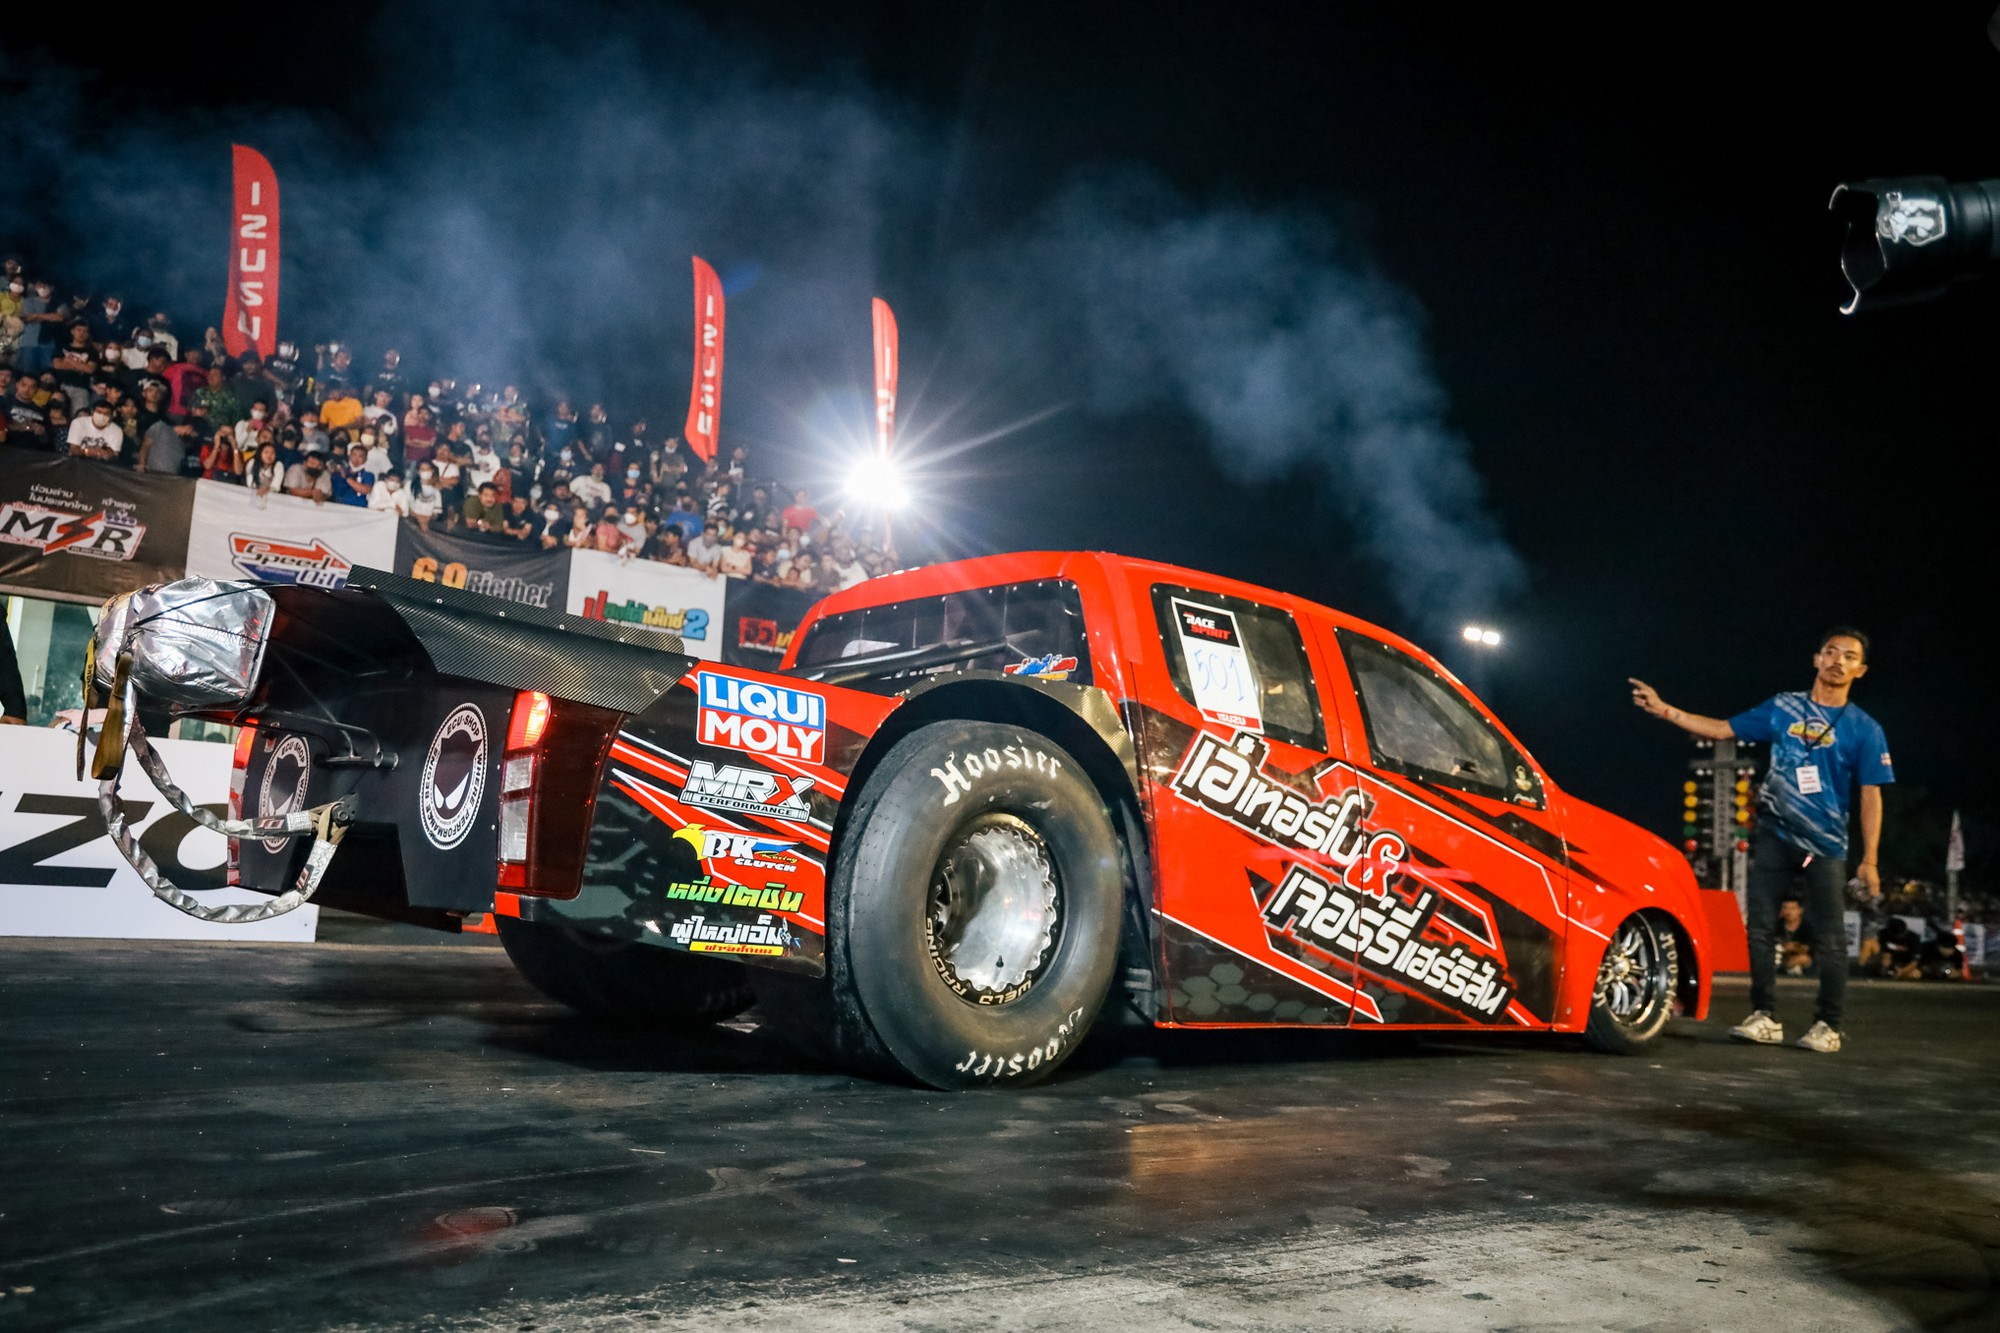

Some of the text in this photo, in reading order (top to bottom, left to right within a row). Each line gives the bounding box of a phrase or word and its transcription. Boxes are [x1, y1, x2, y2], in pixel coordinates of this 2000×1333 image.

[245, 542, 331, 570] Speed
[1183, 612, 1216, 630] RACE
[1194, 649, 1244, 701] 501
[705, 675, 821, 726] LIQUI
[1216, 712, 1247, 726] ISUZU
[704, 711, 823, 760] MOLY
[687, 761, 815, 808] MRX
[931, 738, 1062, 807] Hoosier
[699, 795, 793, 817] PERFORMANCE
[701, 832, 759, 860] BK
[760, 853, 798, 864] Racing
[734, 858, 797, 873] CLUTCH
[926, 917, 968, 996] RACING
[979, 979, 1033, 1006] WELD
